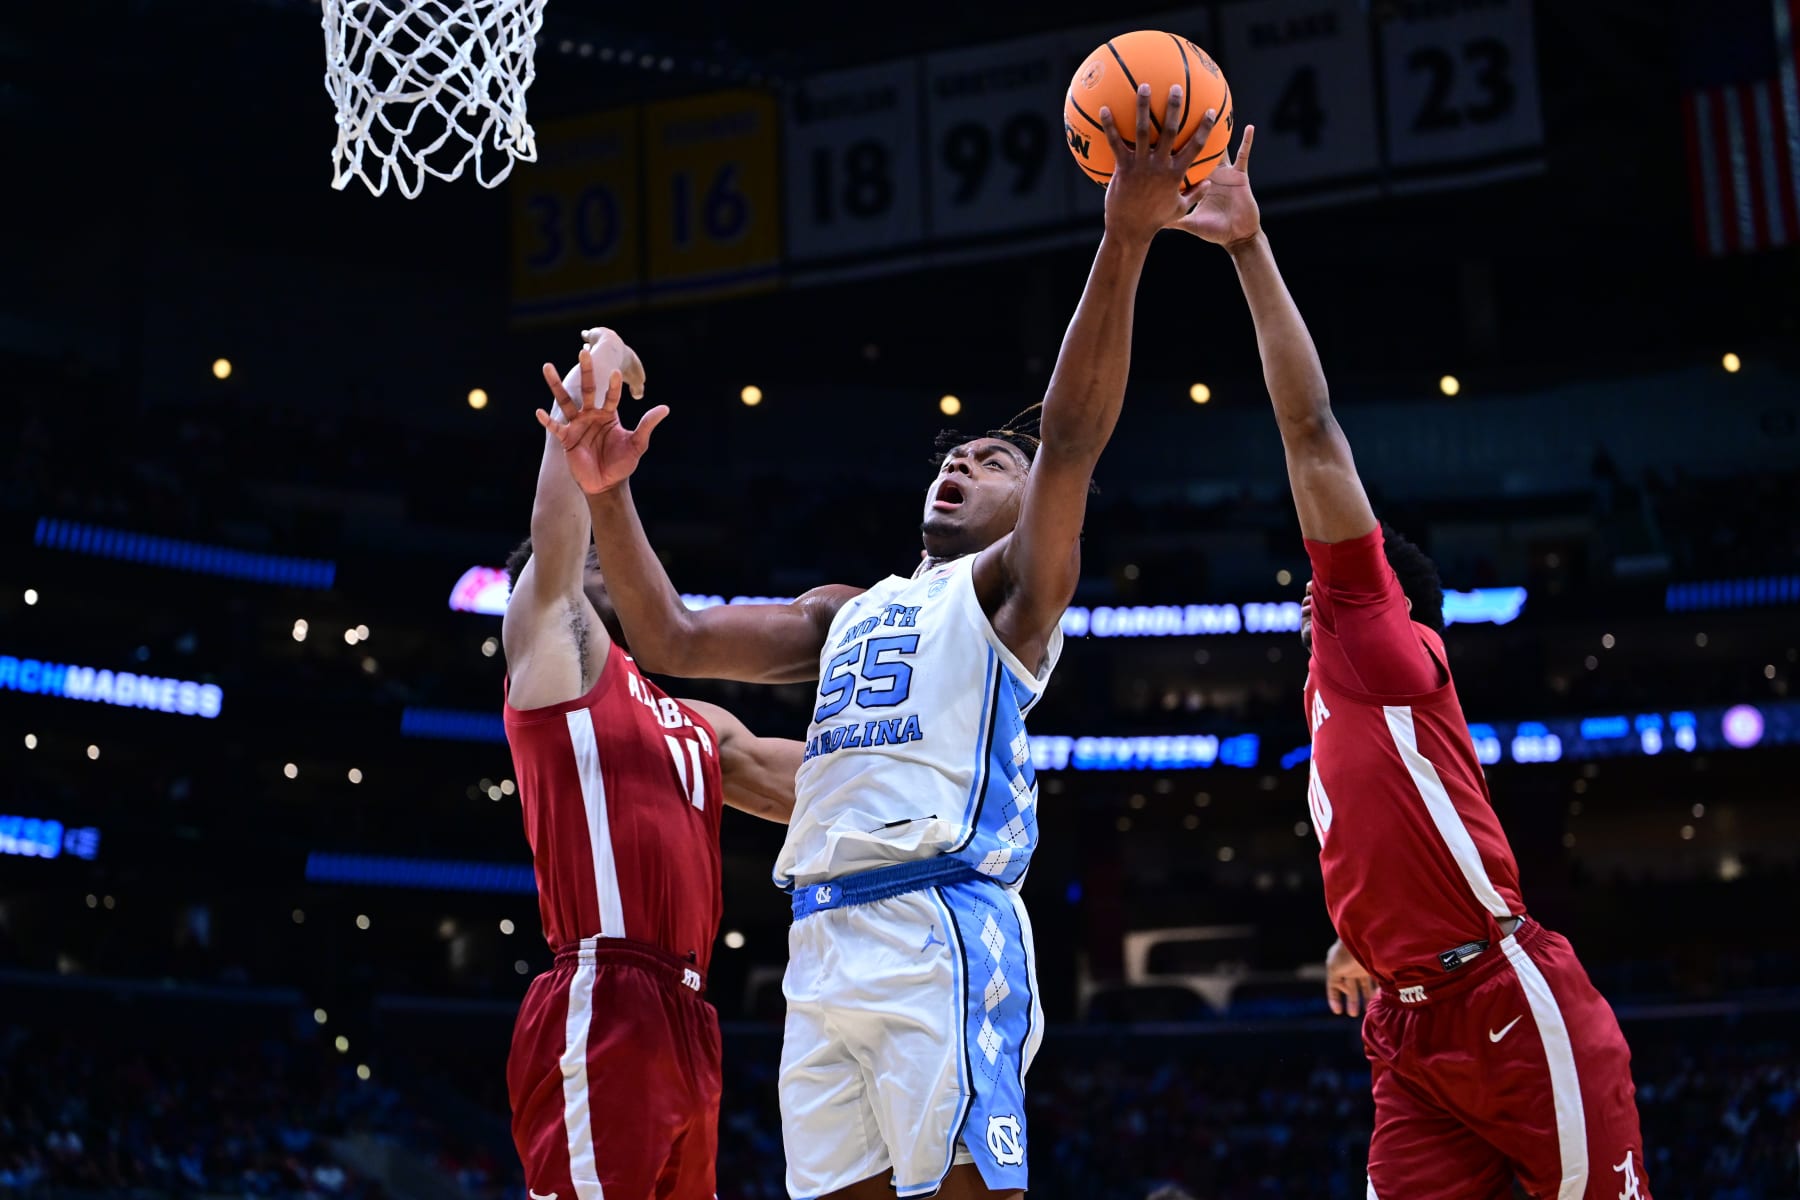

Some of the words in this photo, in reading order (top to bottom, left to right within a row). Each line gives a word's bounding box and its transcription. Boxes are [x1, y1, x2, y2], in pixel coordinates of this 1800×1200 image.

[1269, 65, 1326, 151] 4
[1408, 36, 1518, 133] 23
[811, 137, 894, 226] 18
[943, 111, 1050, 206] 99
[524, 185, 619, 271] 30
[672, 161, 748, 247] 16
[1090, 604, 1239, 637] CAROLINA
[814, 634, 921, 724] 55
[663, 734, 705, 812] 11
